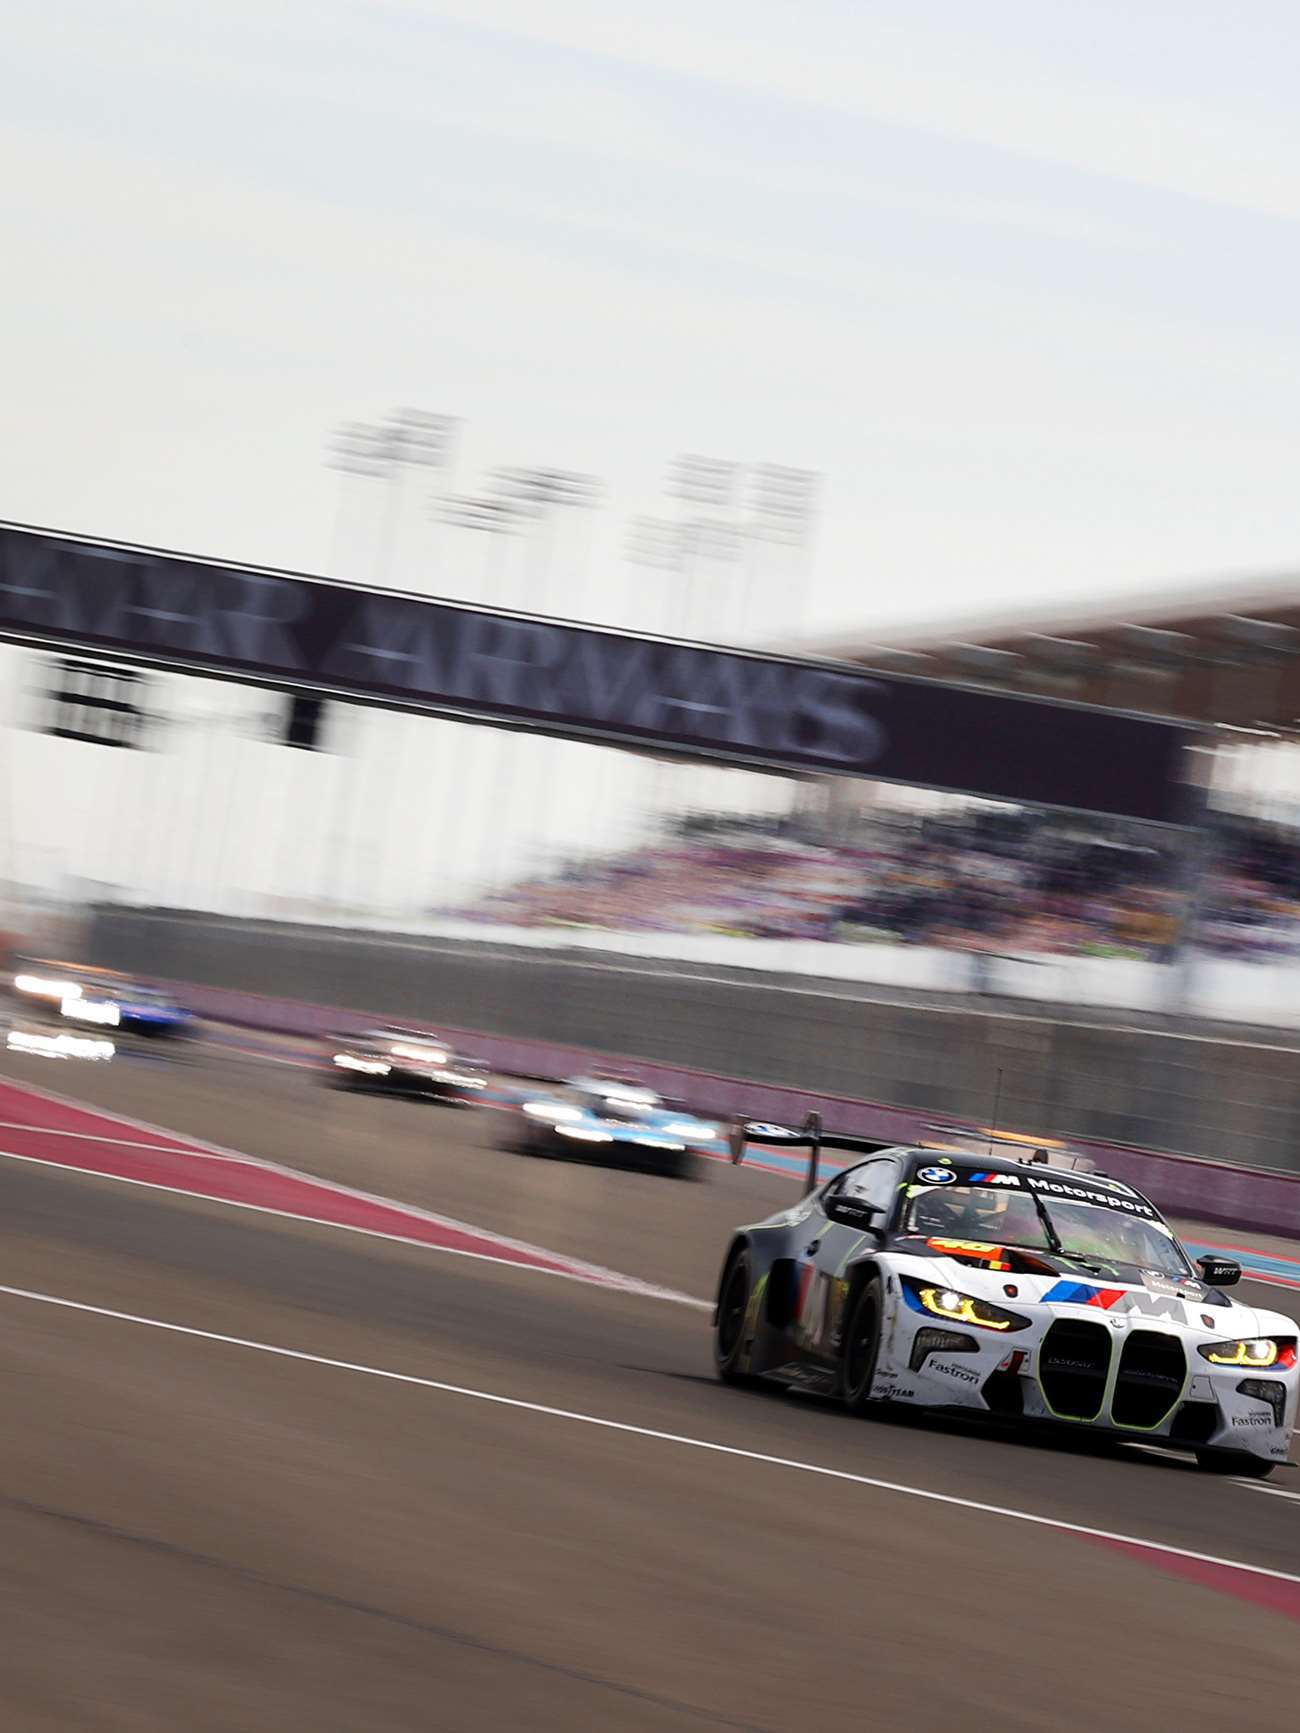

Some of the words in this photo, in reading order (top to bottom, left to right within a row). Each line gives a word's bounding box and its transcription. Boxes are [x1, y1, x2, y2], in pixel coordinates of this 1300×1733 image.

[1027, 1177, 1153, 1217] Motorsport
[929, 1360, 979, 1384] Fastron
[1232, 1416, 1271, 1426] Fastron
